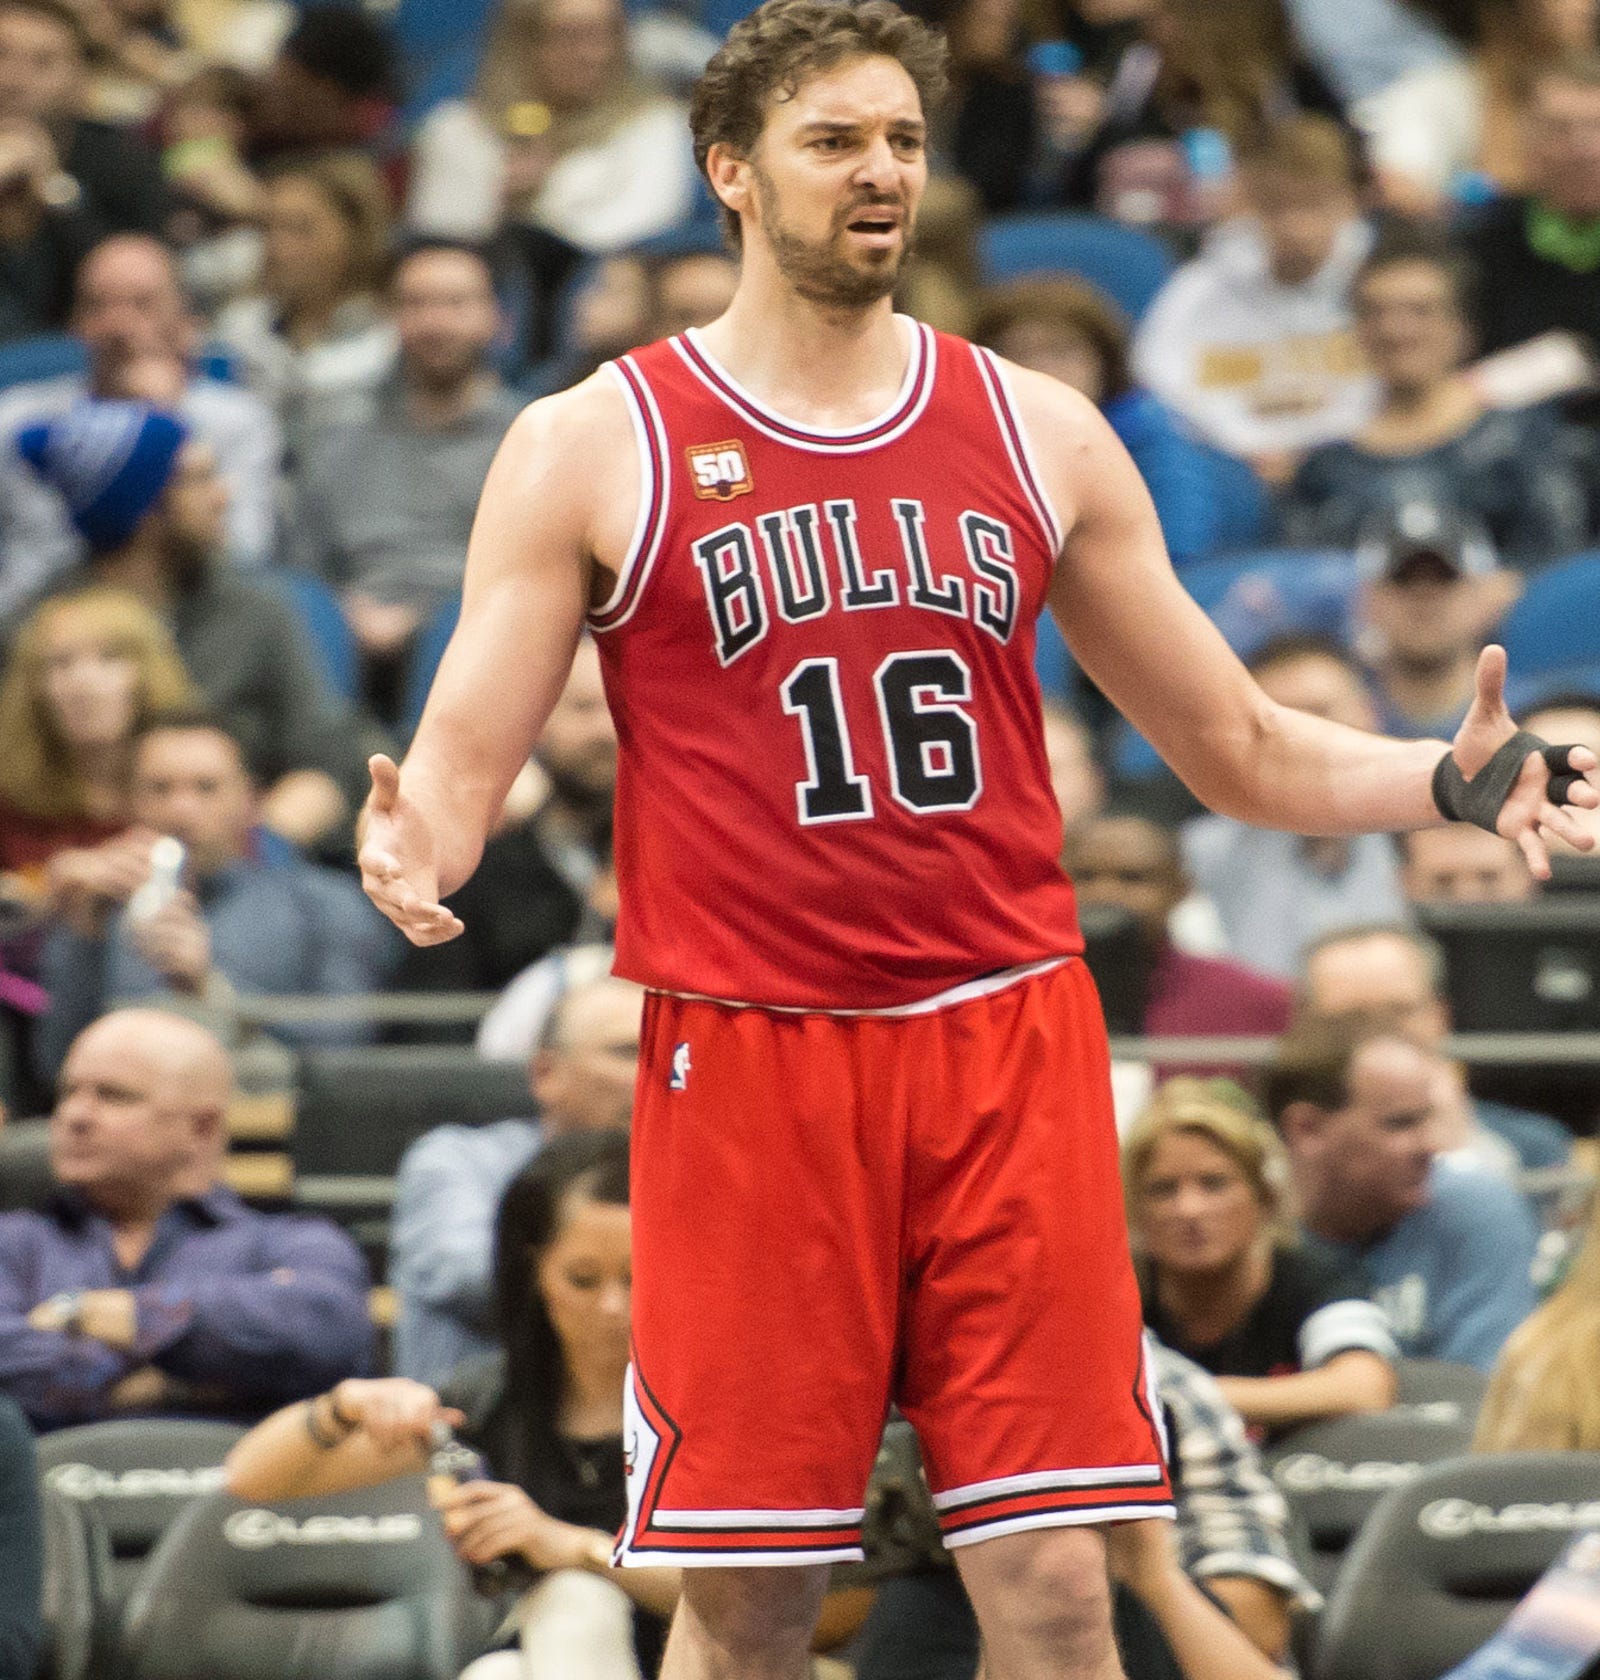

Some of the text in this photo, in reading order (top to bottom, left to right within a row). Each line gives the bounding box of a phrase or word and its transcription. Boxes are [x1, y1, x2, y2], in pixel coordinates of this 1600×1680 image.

[691, 449, 746, 487] 50
[691, 498, 1019, 669] BULLS
[779, 648, 983, 826] 16
